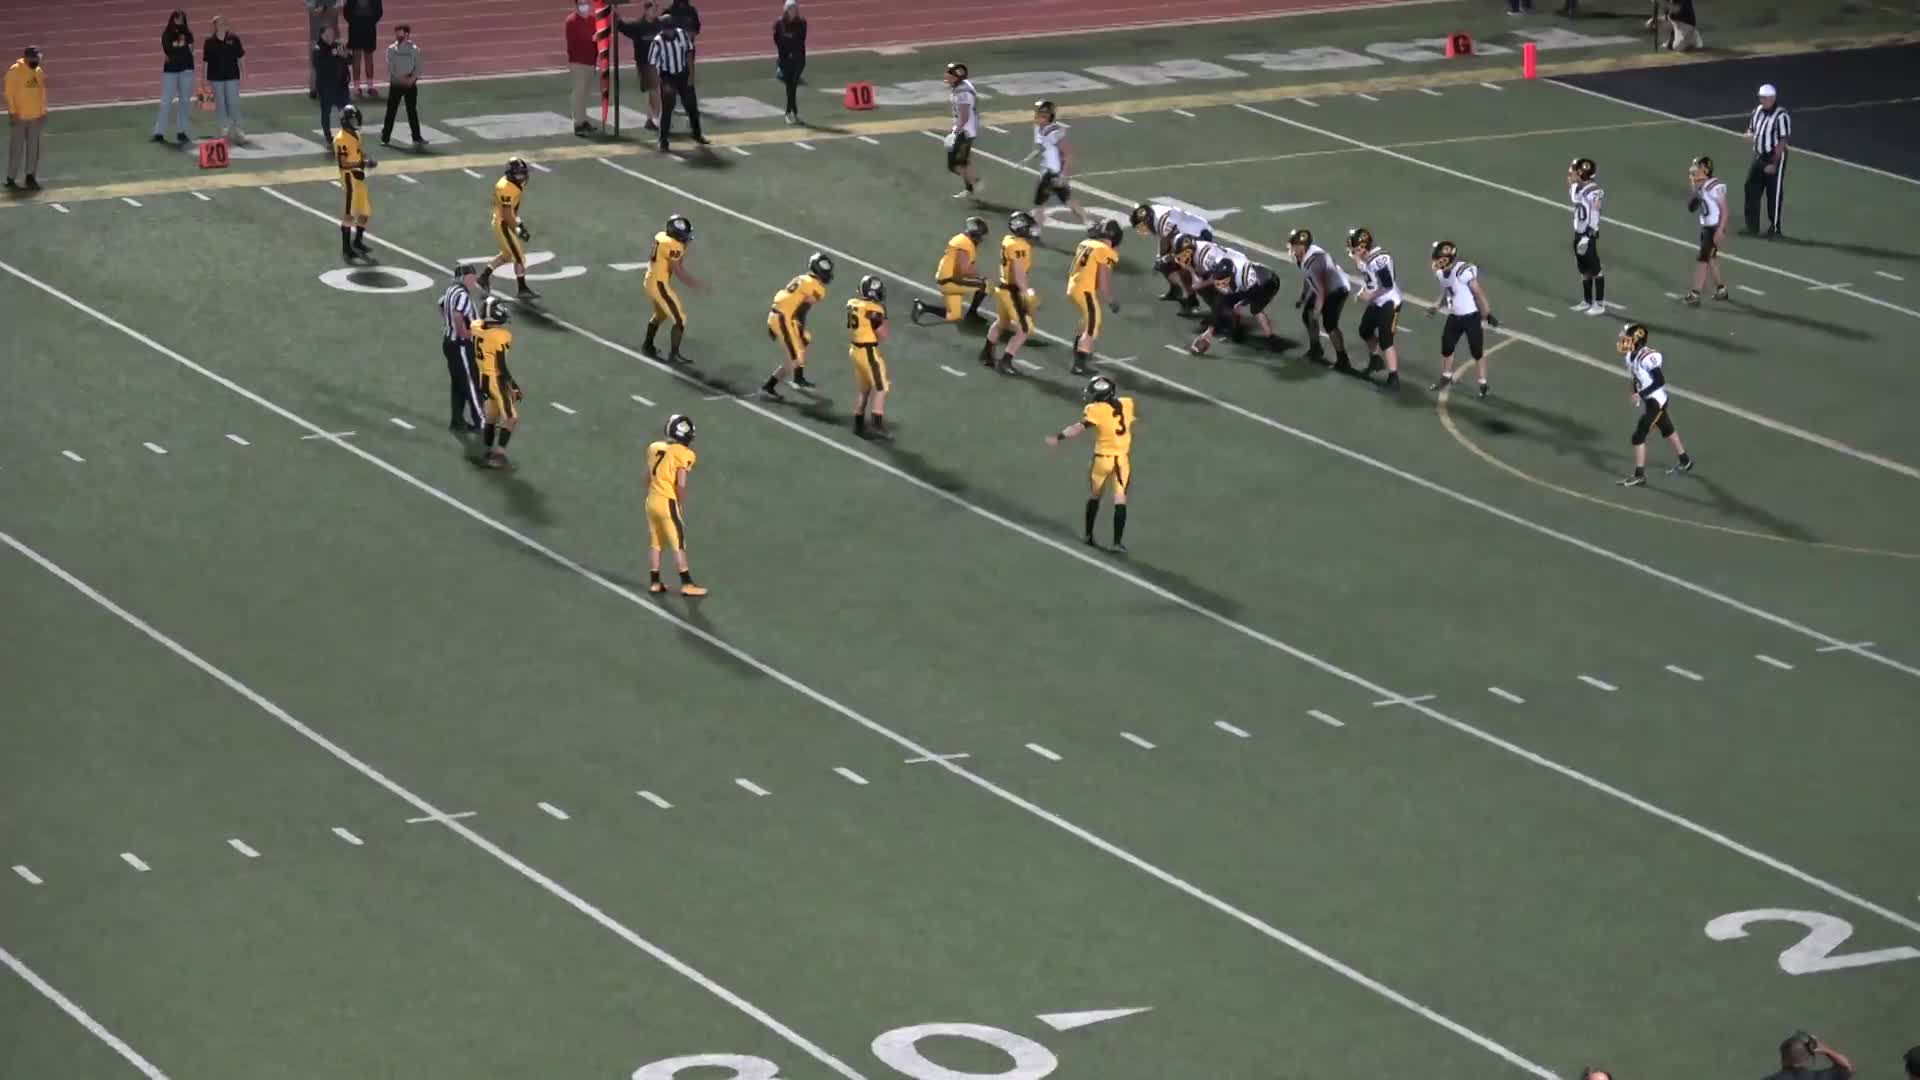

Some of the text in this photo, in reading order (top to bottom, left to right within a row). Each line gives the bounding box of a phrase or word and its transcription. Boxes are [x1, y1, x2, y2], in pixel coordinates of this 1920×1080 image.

[850, 86, 872, 106] 10
[206, 142, 227, 164] 20
[1112, 406, 1127, 436] 3
[652, 450, 667, 476] 7
